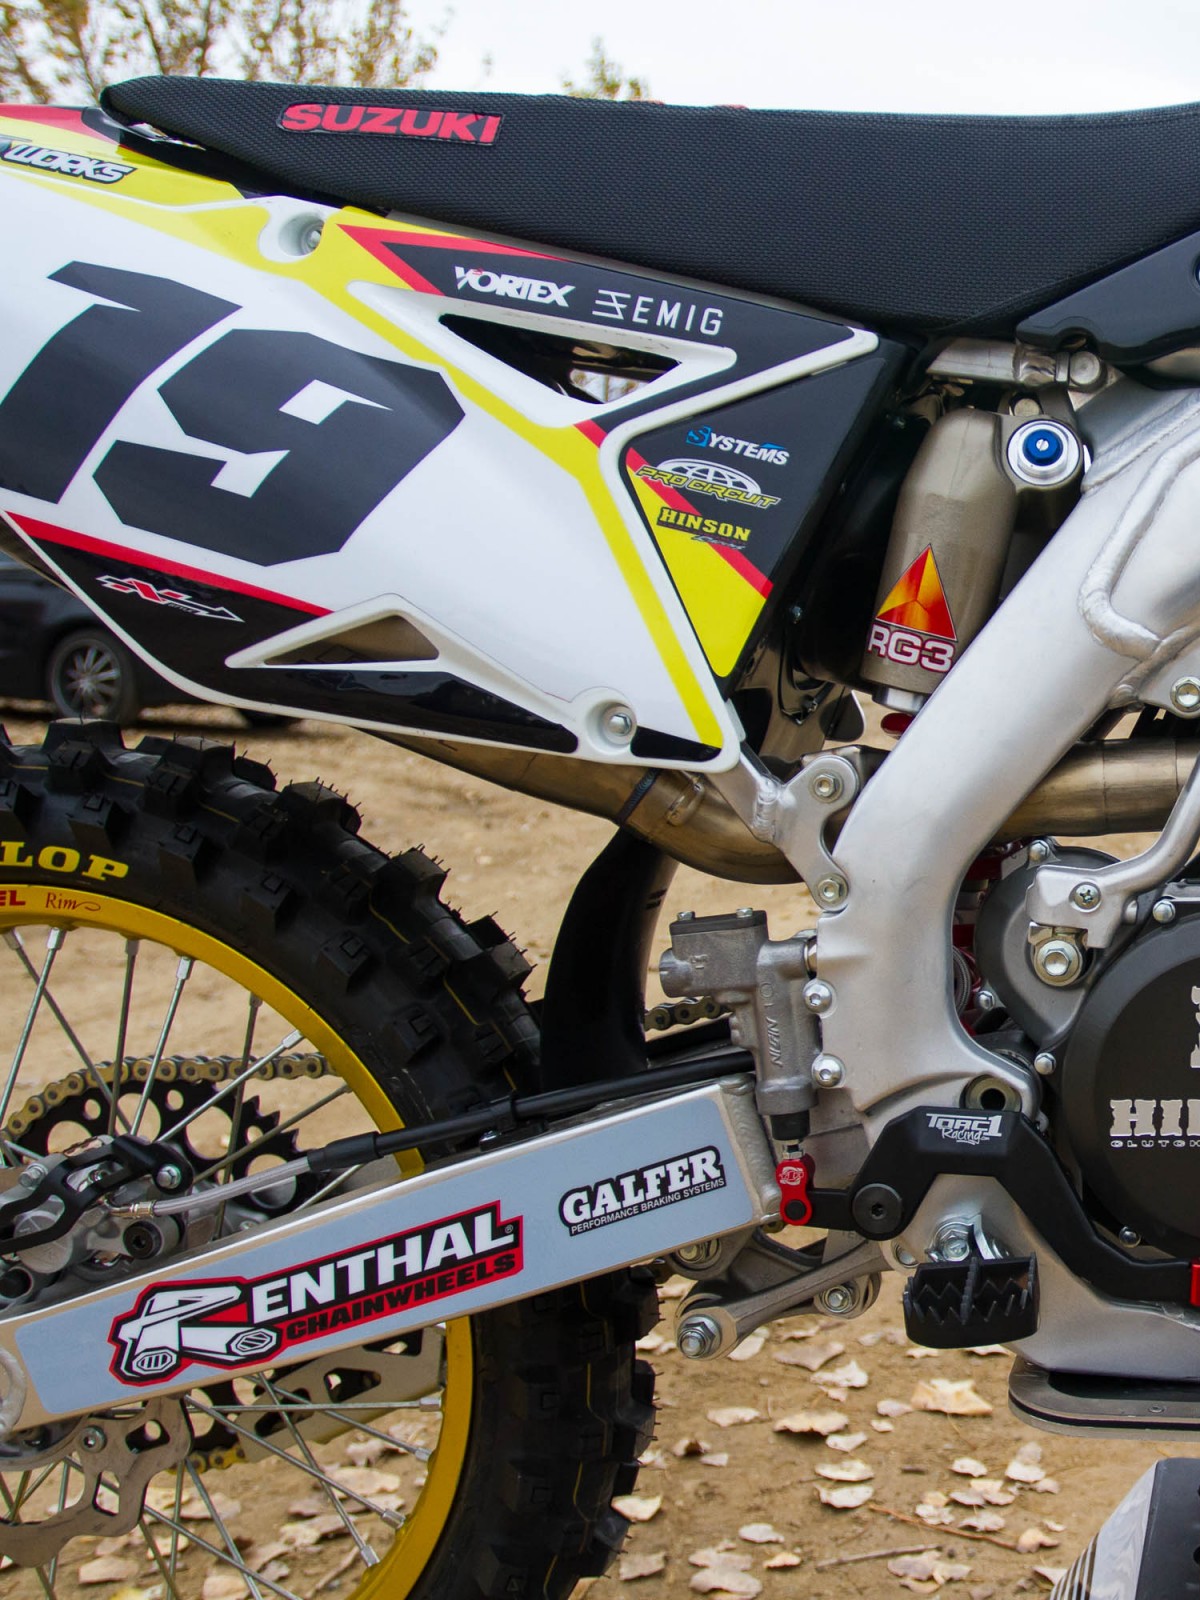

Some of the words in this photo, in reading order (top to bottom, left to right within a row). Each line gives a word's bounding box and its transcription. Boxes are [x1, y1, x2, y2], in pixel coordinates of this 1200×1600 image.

[281, 103, 500, 143] SUZUKI
[3, 143, 137, 182] WORKS
[454, 265, 576, 307] VORTEX
[632, 295, 724, 336] EMIG
[0, 260, 466, 567] 19
[686, 424, 790, 466] SYSTEMS
[636, 464, 690, 488] PRO
[686, 478, 781, 509] CIRCUIT
[659, 508, 752, 542] HINSON
[867, 622, 955, 674] RG3
[45, 891, 101, 912] Rim
[941, 1127, 990, 1146] Racing
[562, 1149, 721, 1224] GALFER
[571, 1204, 640, 1235] PERFORMANCE
[640, 1191, 682, 1212] BRAKING
[683, 1177, 725, 1199] SYSTEMS
[285, 1252, 516, 1341] CHAINWHEELS
